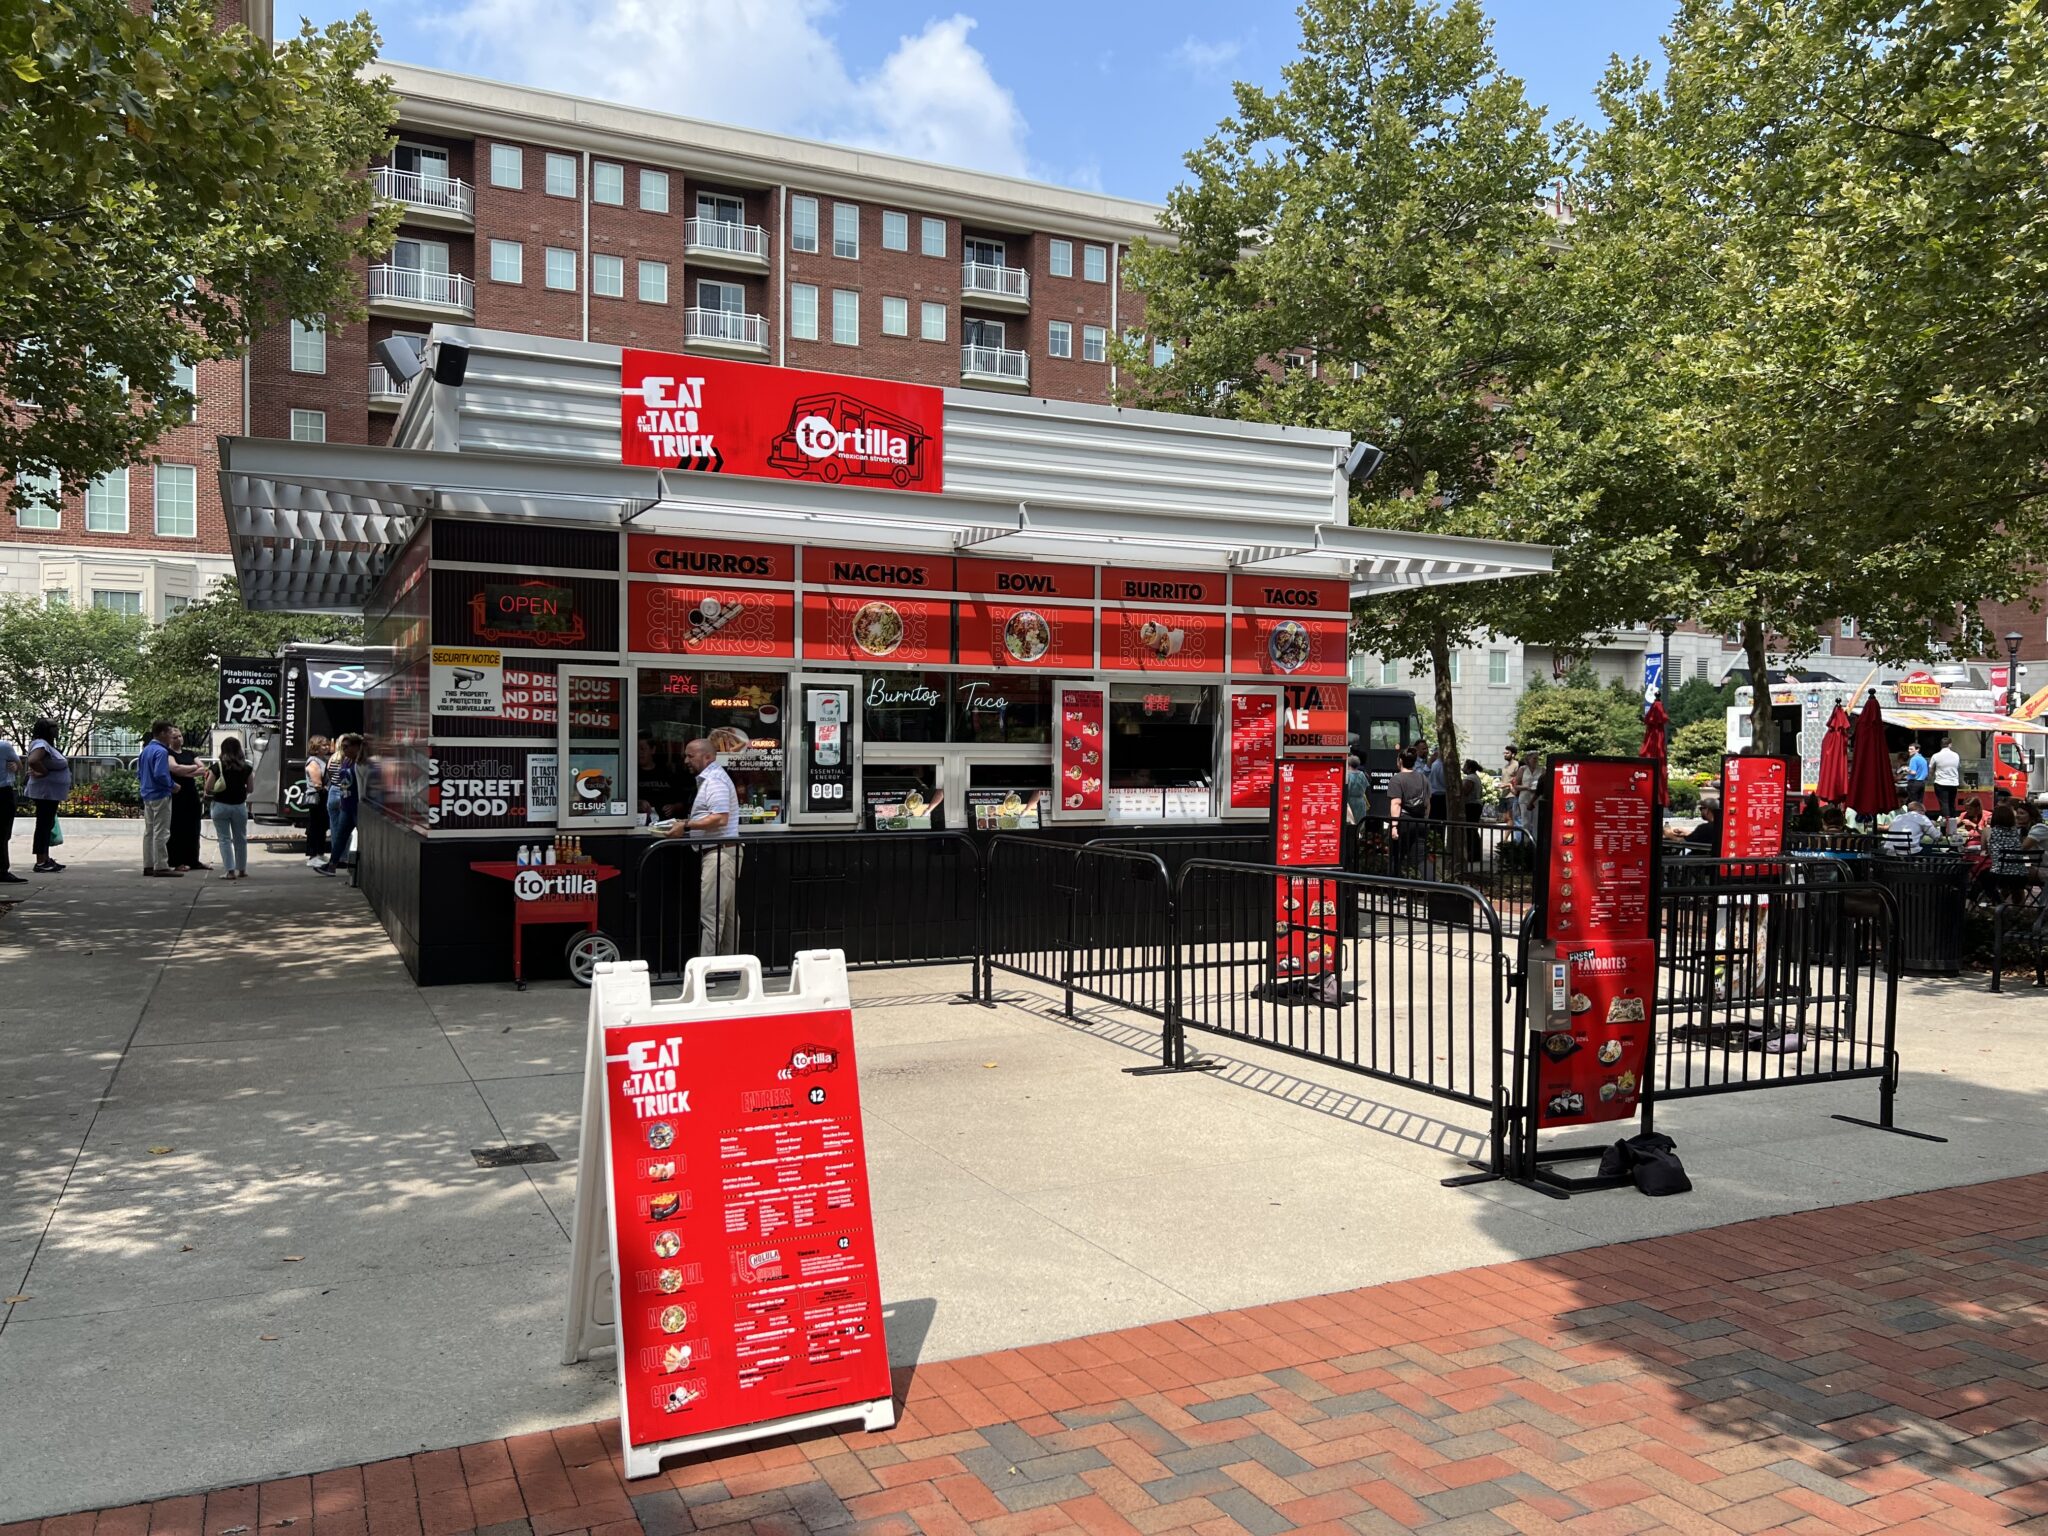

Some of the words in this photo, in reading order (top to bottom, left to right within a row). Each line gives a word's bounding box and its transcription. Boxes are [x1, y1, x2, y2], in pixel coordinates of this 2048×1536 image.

[641, 376, 705, 409] EAT
[637, 415, 646, 424] AT
[637, 423, 652, 433] THE
[646, 410, 698, 433] TACO
[649, 434, 717, 458] TRUCK
[797, 416, 907, 458] tortilla
[838, 452, 868, 461] mexican
[869, 455, 890, 463] street
[891, 456, 907, 465] food
[654, 549, 769, 576] CHURROS
[834, 562, 925, 586] NACHOS
[997, 573, 1057, 593] BOWL
[1125, 580, 1203, 601] BURRITO
[1263, 588, 1318, 606] TACOS
[500, 595, 558, 616] OPEN
[826, 599, 928, 621] NAOS
[826, 636, 928, 659] NAOS
[1120, 630, 1206, 651] BUTO
[432, 652, 470, 663] SECURITY
[472, 653, 500, 664] NOTICE
[222, 669, 277, 679] Pitabilities.com
[227, 678, 273, 686] 614.216.6310
[670, 675, 692, 684] PAY
[532, 674, 611, 693] DELIOUS
[663, 684, 698, 694] HERE
[866, 678, 941, 707] Burritos
[1900, 685, 1922, 695] SAUSAGE
[1923, 686, 1939, 696] TRUCK
[460, 690, 489, 698] PROPERTY
[733, 699, 749, 707] SALSA
[959, 682, 1008, 711] Taco
[224, 693, 273, 724] Pita
[1144, 703, 1169, 711] HERE
[532, 708, 611, 726] DELIOUS
[441, 760, 513, 778] tortilla
[532, 766, 539, 776] IT
[441, 779, 524, 797] STREET
[532, 776, 555, 786] BETTER
[532, 787, 548, 797] WITH
[549, 787, 555, 796] A
[532, 796, 558, 806] TRACTO
[572, 802, 606, 810] CELSIUS
[516, 873, 597, 897] tortilla
[1578, 956, 1627, 971] FAVORITES
[627, 1037, 683, 1072] EAT
[792, 1052, 832, 1069] tortilla
[623, 1079, 632, 1089] AT
[631, 1069, 677, 1096] TACO
[623, 1087, 636, 1097] THE
[632, 1090, 691, 1119] TRUCK
[748, 1249, 781, 1268] CHOLULA
